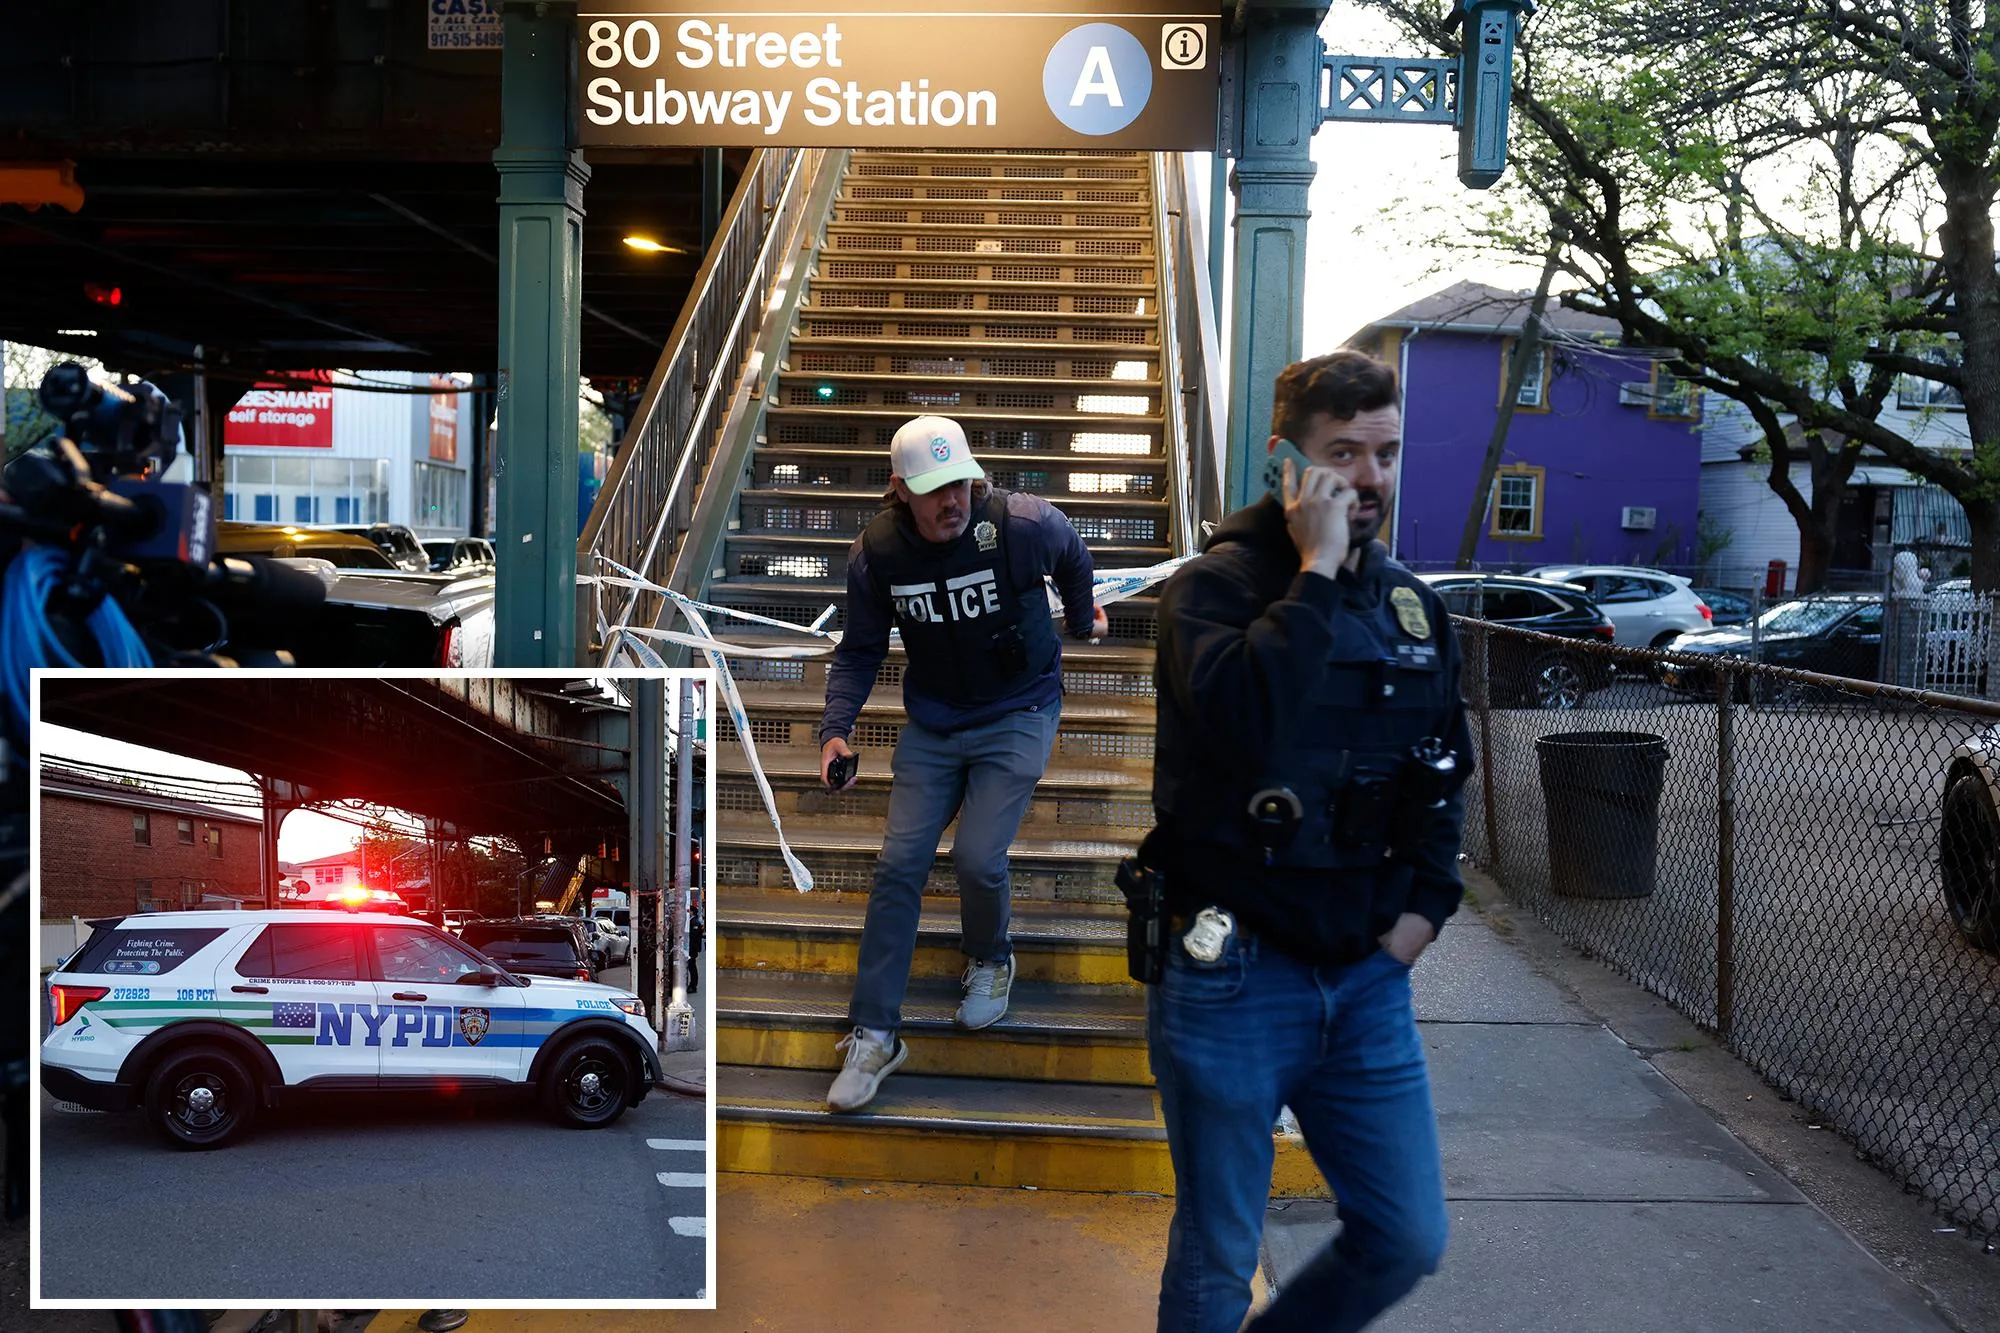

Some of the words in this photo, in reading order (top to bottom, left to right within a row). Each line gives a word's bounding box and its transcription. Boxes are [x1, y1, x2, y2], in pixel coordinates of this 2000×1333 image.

[444, 16, 466, 24] ALL
[586, 20, 661, 68] 80
[676, 19, 843, 69] Street
[1069, 46, 1124, 107] A
[586, 77, 793, 135] Subway
[803, 76, 997, 126] Station
[236, 390, 332, 409] BESMART
[229, 408, 257, 423] self
[259, 410, 316, 427] storage
[892, 582, 1001, 622] POLICE
[116, 949, 149, 957] Protecting
[127, 939, 153, 948] Fighting
[155, 939, 175, 947] Crime
[113, 988, 150, 1000] 372923
[177, 989, 193, 1001] 106
[196, 989, 215, 1001] PCT
[575, 999, 612, 1009] POLICE
[316, 1002, 452, 1047] NYPD
